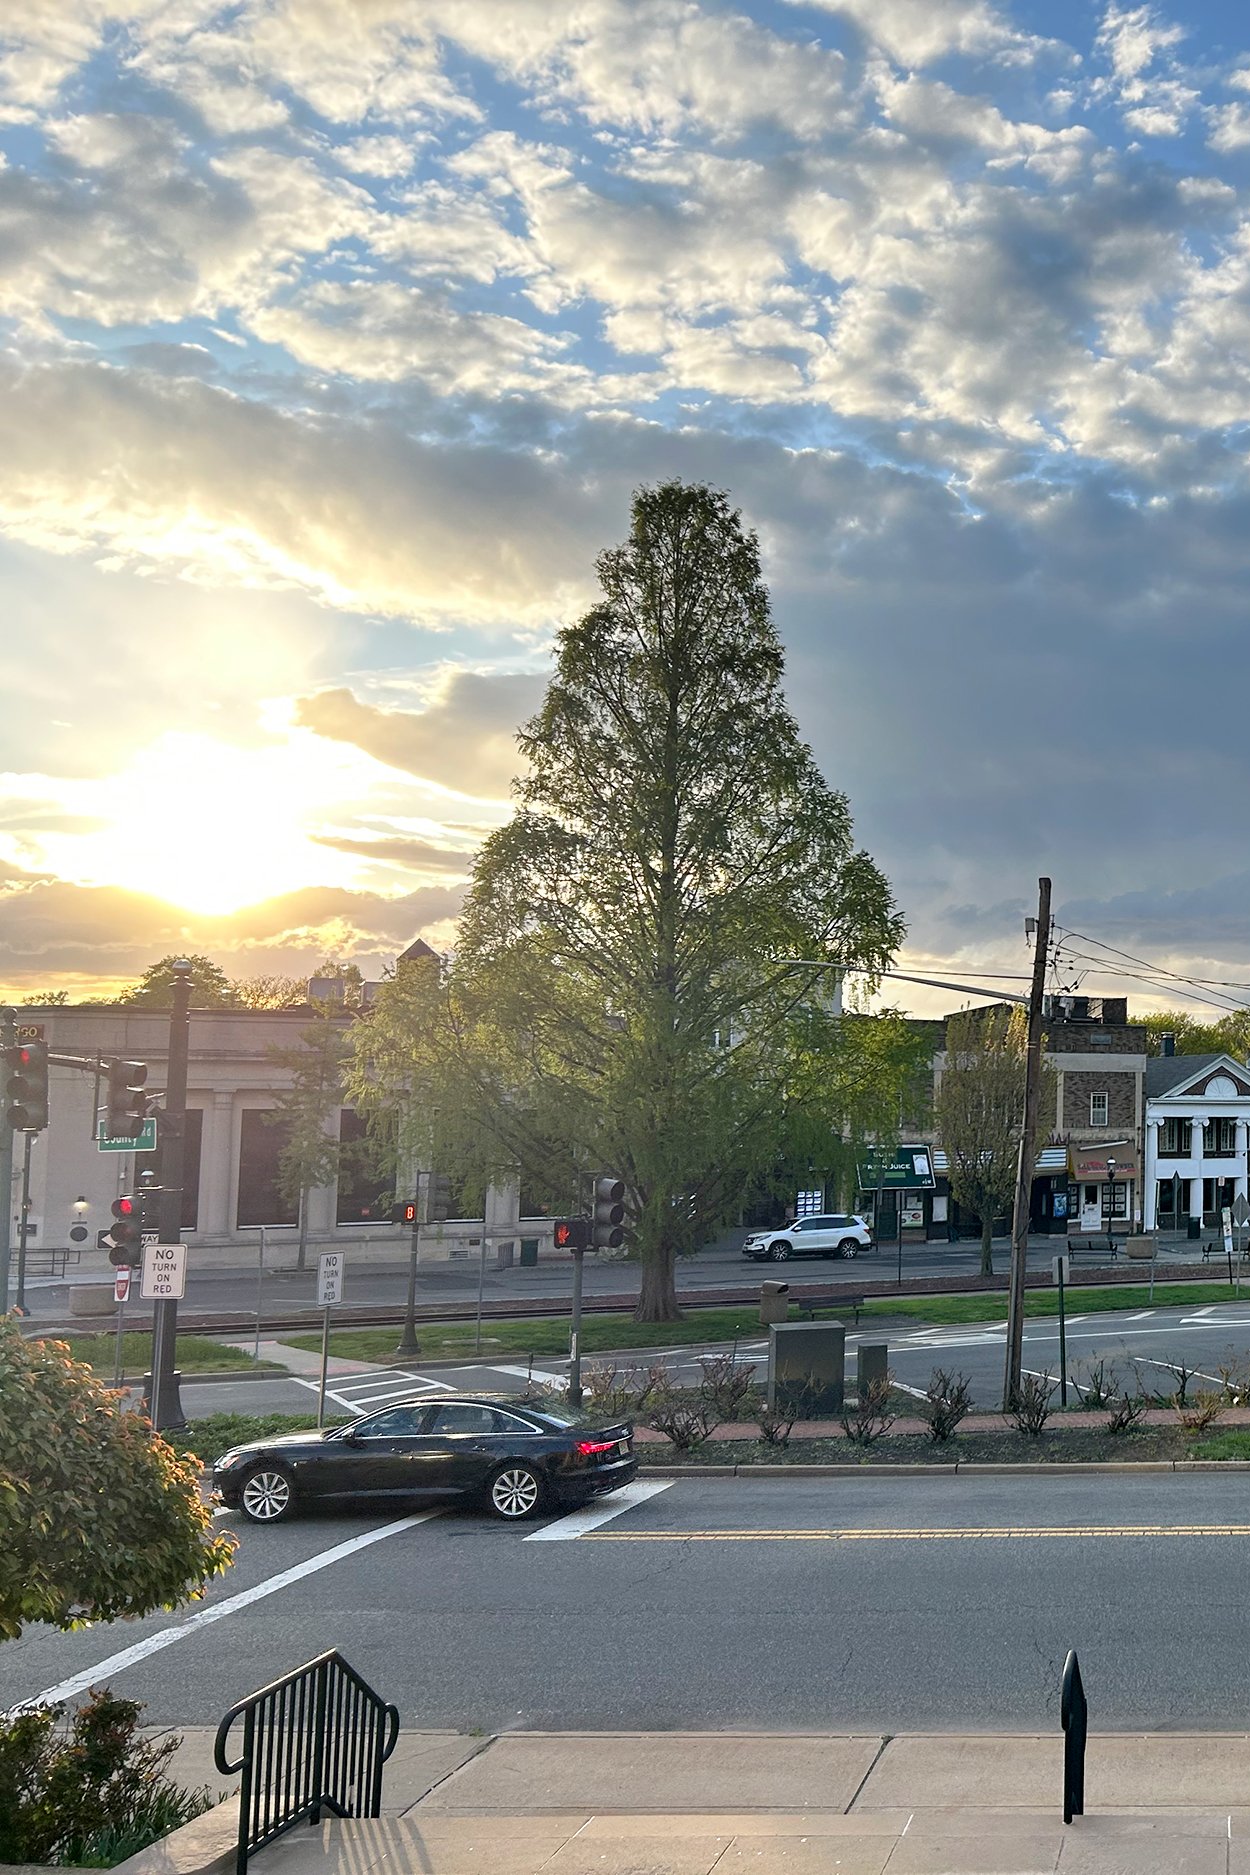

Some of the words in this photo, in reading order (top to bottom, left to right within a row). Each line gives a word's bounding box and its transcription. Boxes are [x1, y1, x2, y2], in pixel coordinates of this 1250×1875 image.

[155, 1249, 174, 1260] NO
[325, 1256, 338, 1267] NO
[152, 1263, 177, 1271] TURN
[157, 1273, 170, 1282] ON
[323, 1269, 339, 1279] TURN
[153, 1284, 172, 1293] RED
[326, 1280, 335, 1290] ON
[323, 1291, 336, 1301] RED
